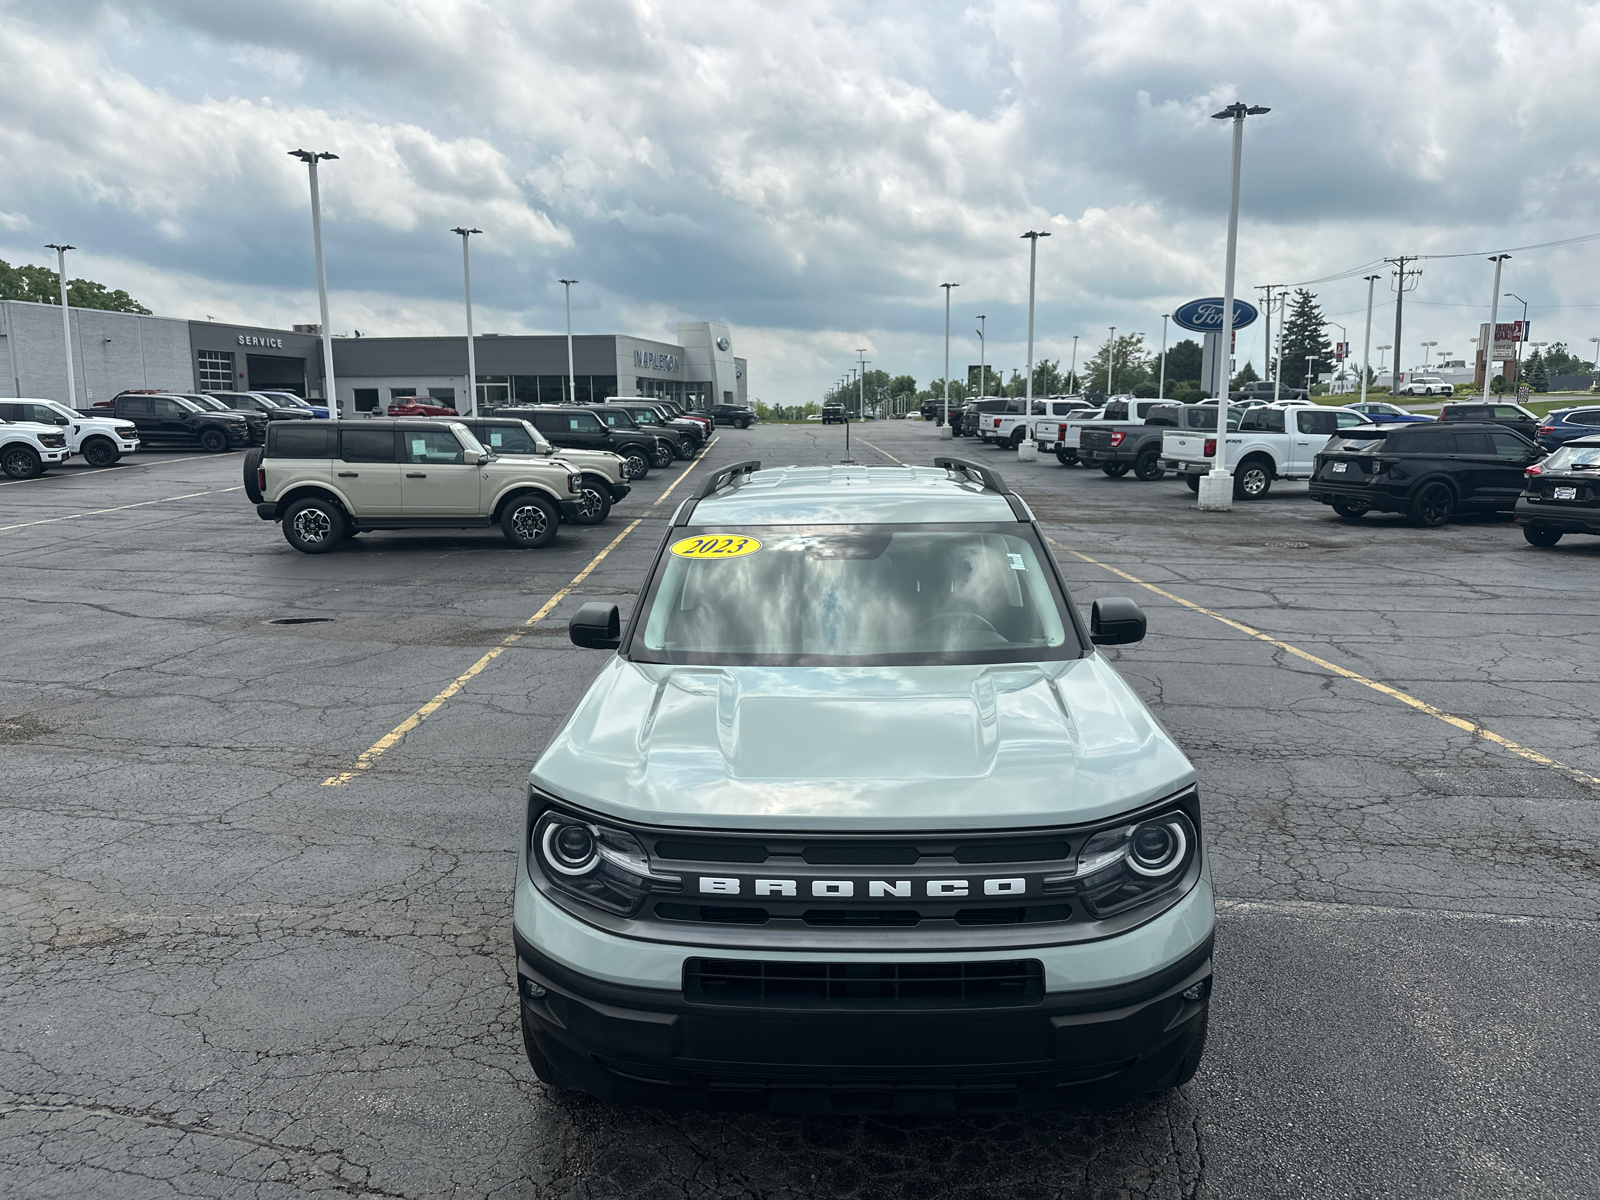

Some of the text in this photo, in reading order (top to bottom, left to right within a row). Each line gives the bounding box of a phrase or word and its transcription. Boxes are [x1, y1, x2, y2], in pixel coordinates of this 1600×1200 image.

[238, 334, 283, 348] SERVICE
[634, 350, 679, 372] NAPLETON
[682, 539, 749, 554] 2023
[699, 876, 1026, 897] BRONCO
